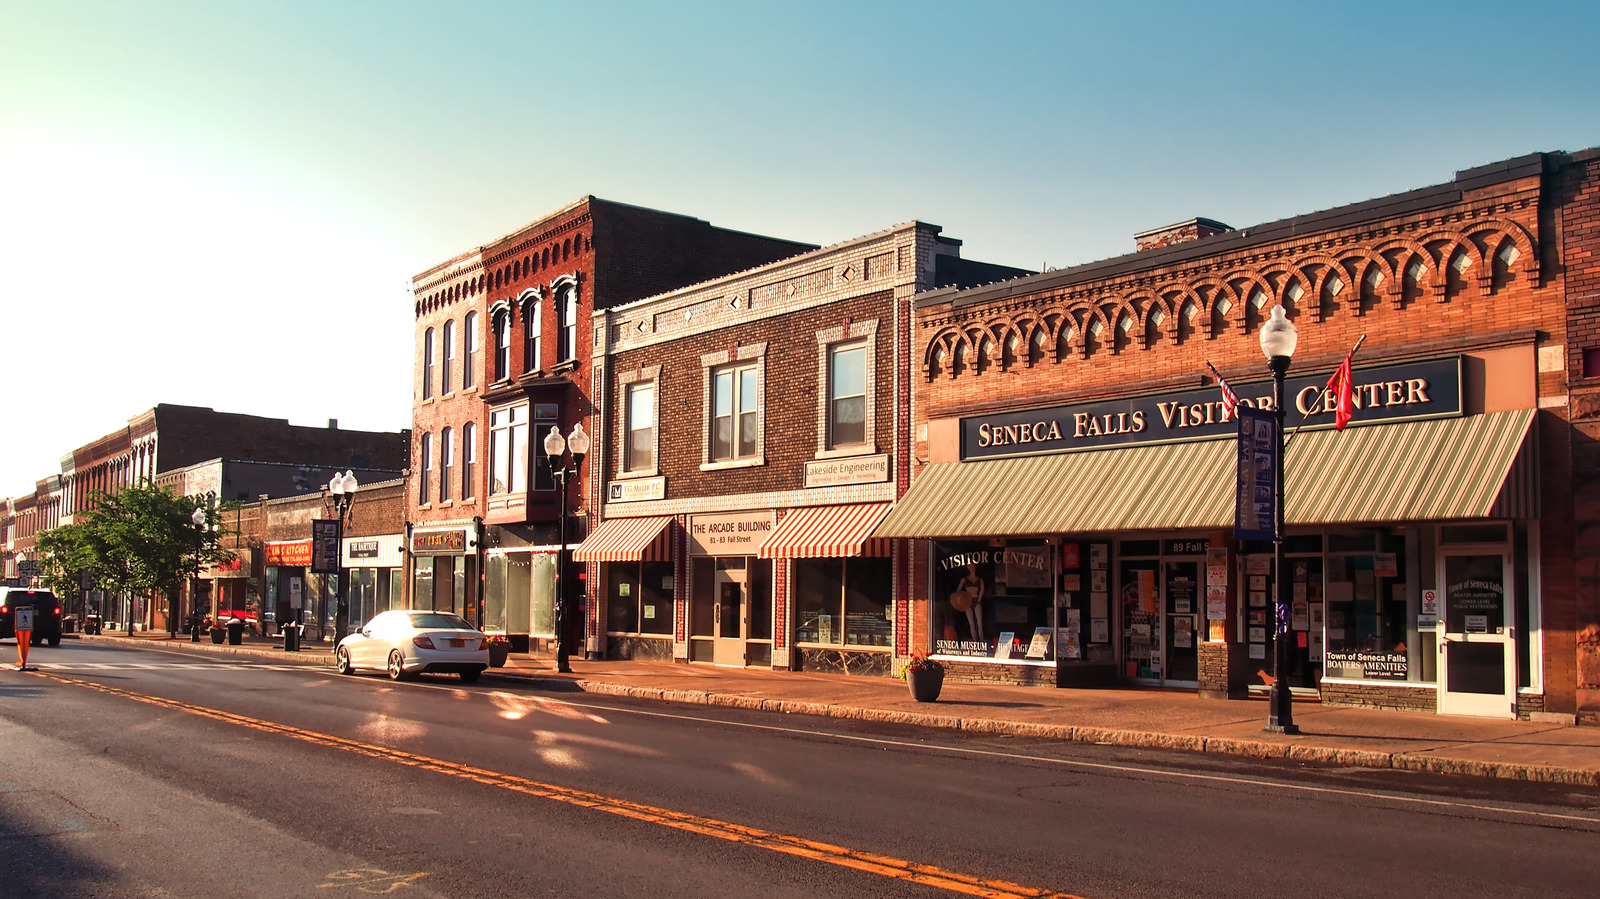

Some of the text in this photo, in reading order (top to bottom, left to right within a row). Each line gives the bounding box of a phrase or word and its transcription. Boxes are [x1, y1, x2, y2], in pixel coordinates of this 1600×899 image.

[978, 420, 1063, 448] SENECA
[1073, 410, 1147, 439] FALLS
[1295, 377, 1430, 416] CENTER
[806, 460, 886, 476] Lakeside Engineering
[1240, 468, 1249, 528] SENECA
[693, 520, 771, 534] THE ARCADE BUILDING
[736, 535, 751, 543] Street
[1173, 543, 1183, 552] 89
[1186, 542, 1202, 552] Fall
[941, 551, 1044, 571] VISITOR CENTER
[1470, 580, 1489, 590] Seneca
[1490, 582, 1503, 594] Falls
[936, 639, 959, 650] SENECA
[960, 641, 988, 651] MUSEUM
[1326, 651, 1407, 663] Town of Seneca Falls
[1327, 660, 1408, 672] BOATERS AMENITIES
